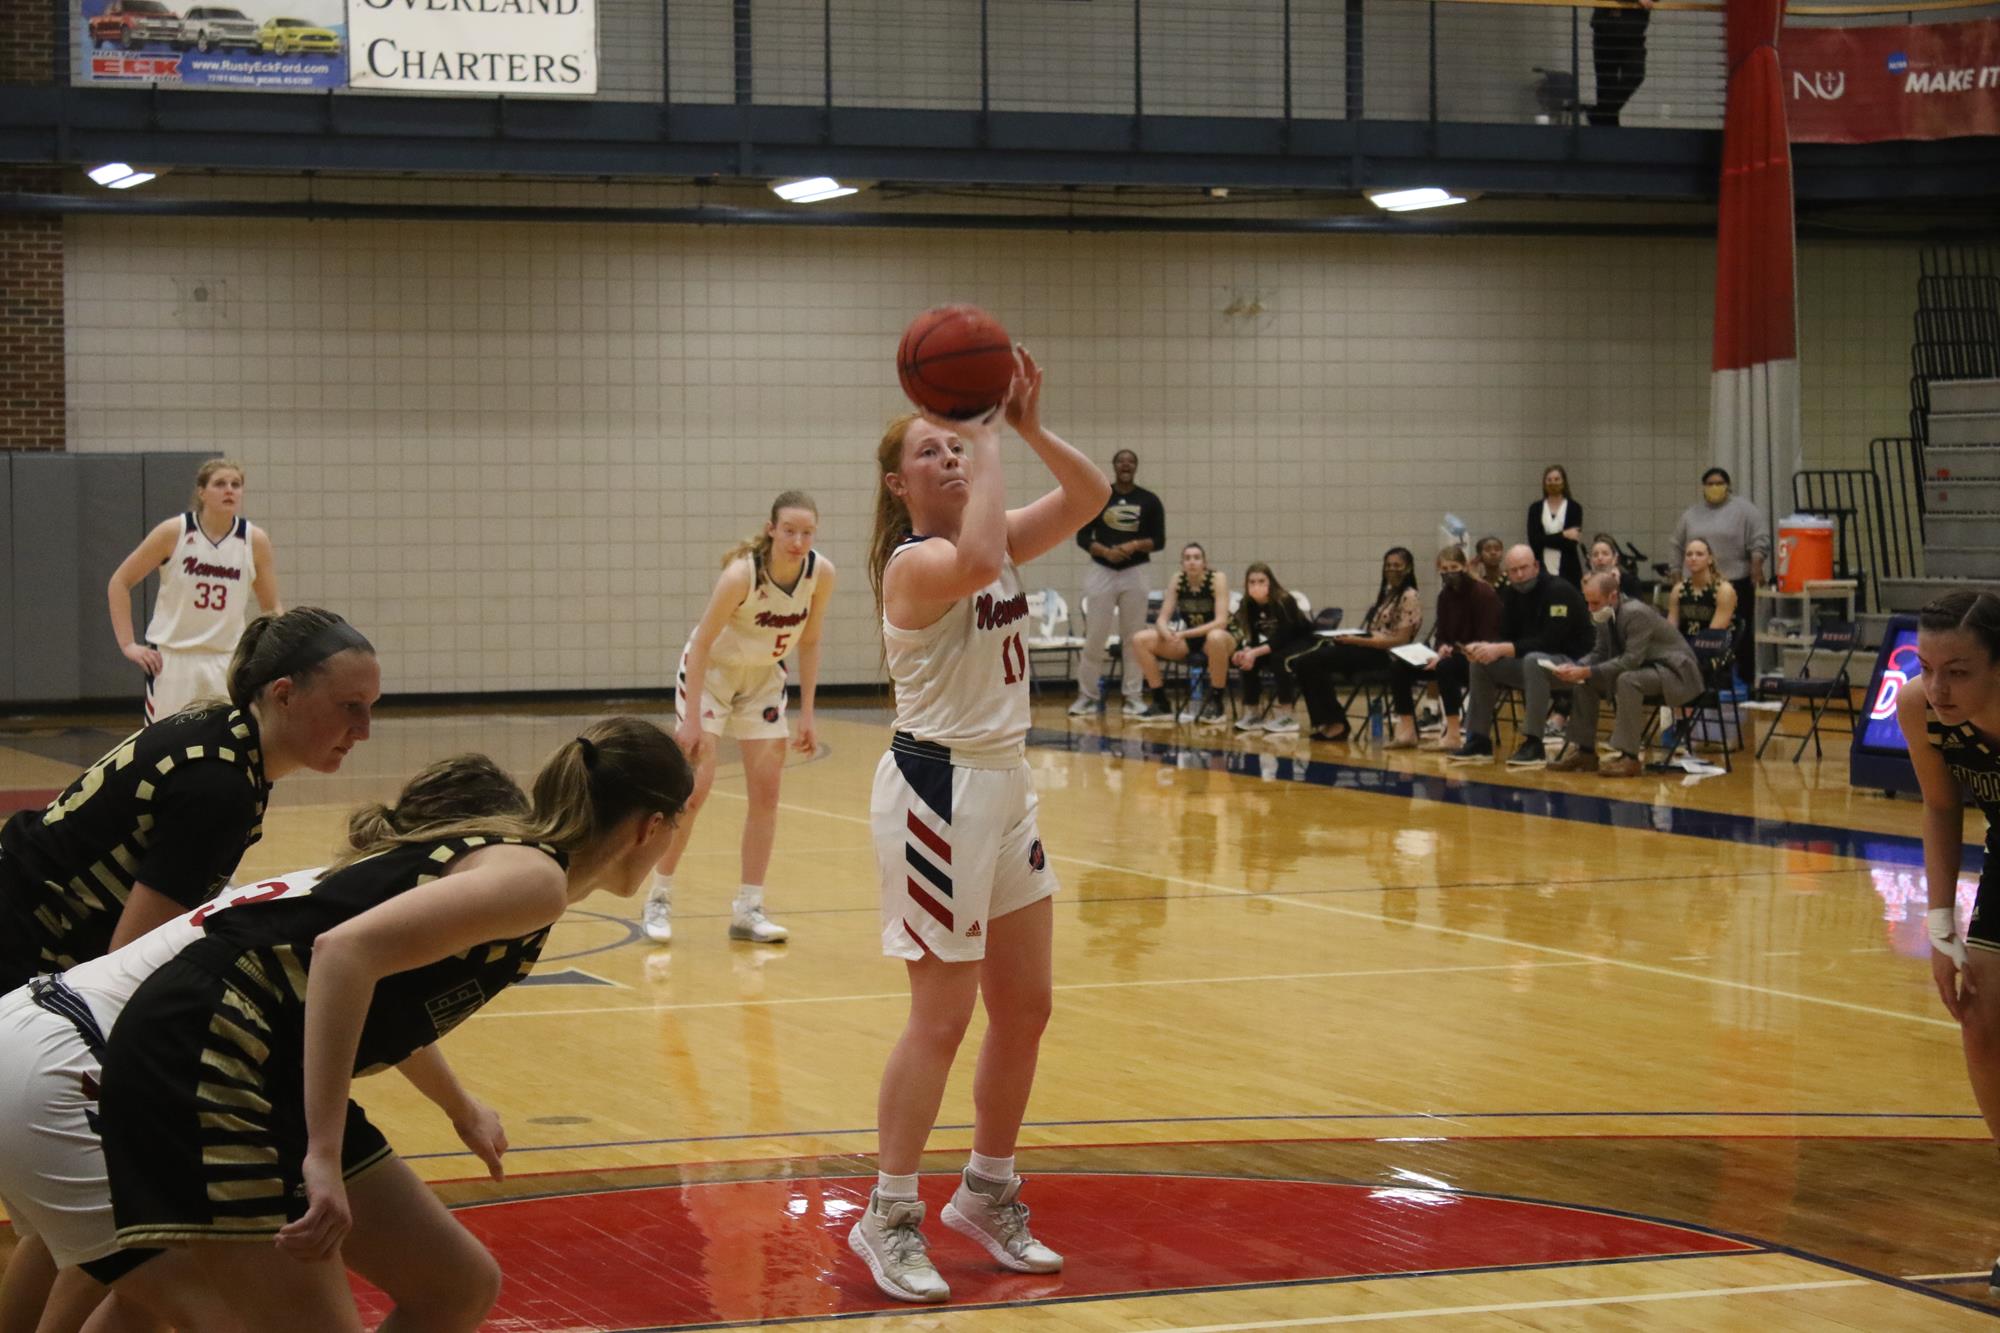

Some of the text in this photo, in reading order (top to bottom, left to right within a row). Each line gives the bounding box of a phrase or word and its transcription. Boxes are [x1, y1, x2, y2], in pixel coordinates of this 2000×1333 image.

[367, 38, 581, 83] CHARTERS
[1905, 65, 2000, 94] MAKE IT
[194, 582, 227, 611] 33
[772, 633, 792, 657] 5
